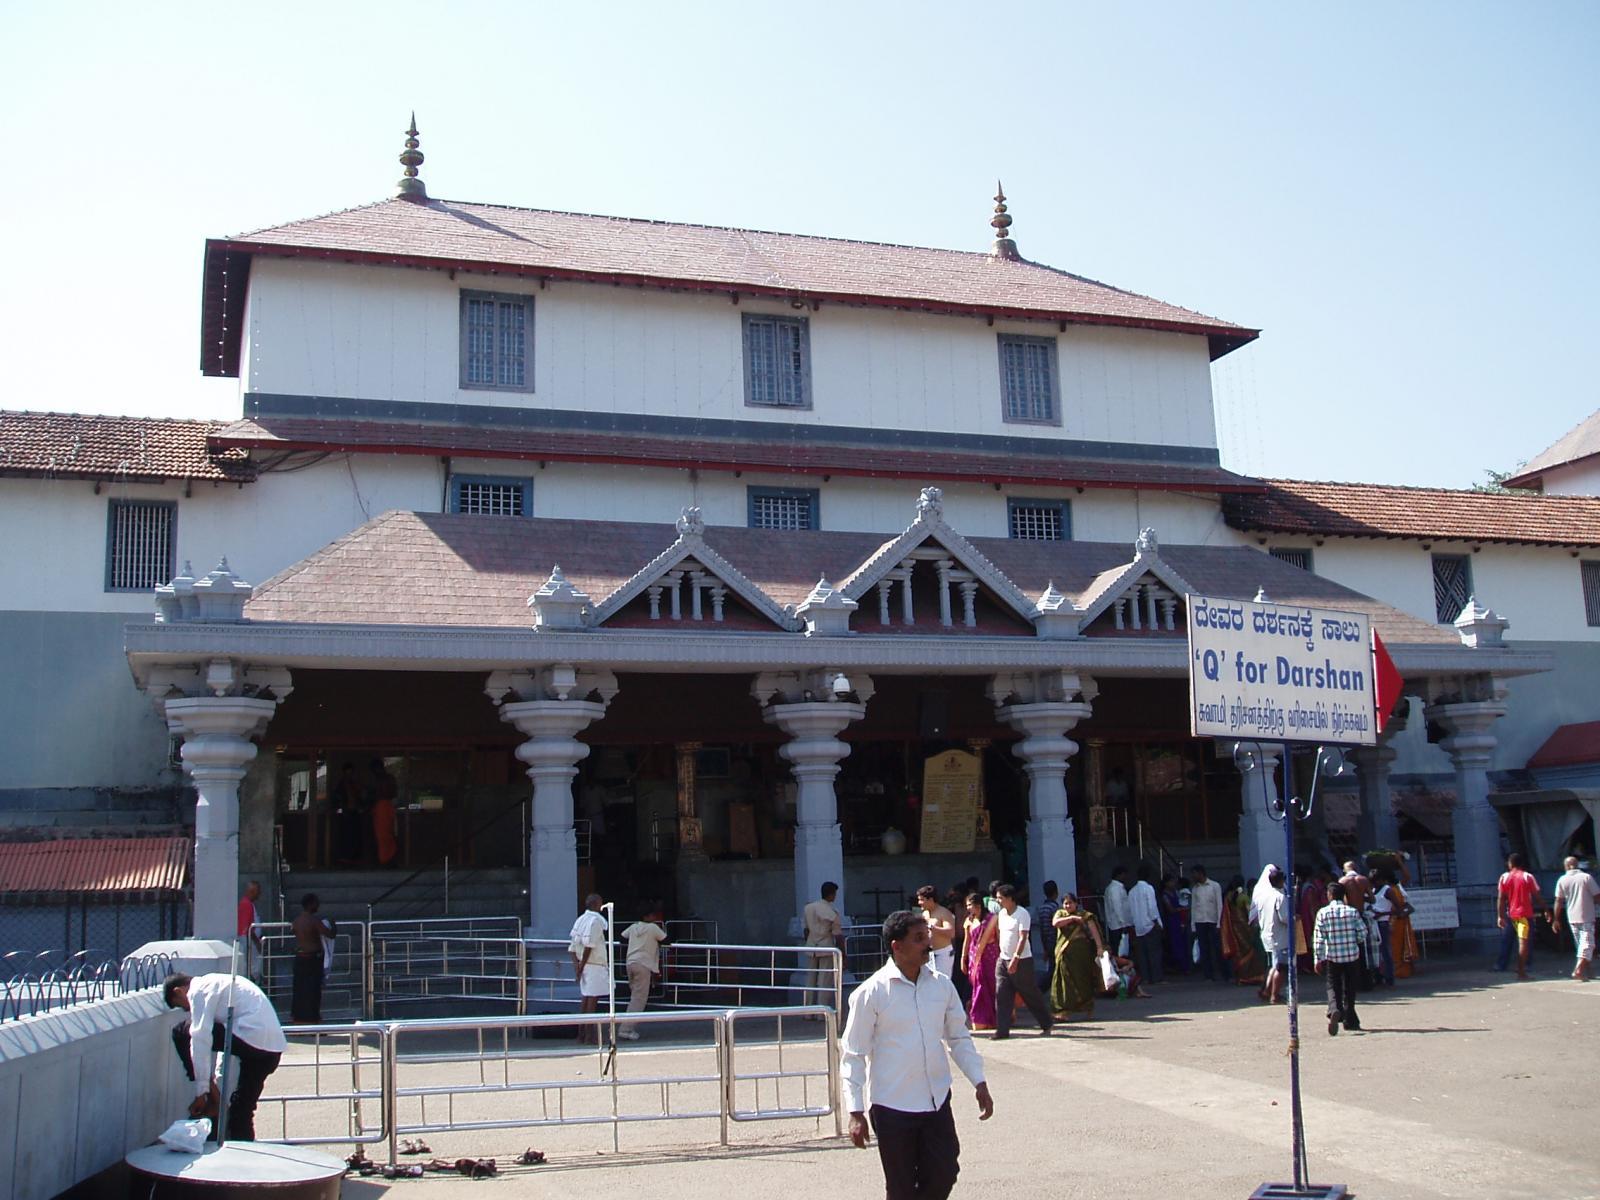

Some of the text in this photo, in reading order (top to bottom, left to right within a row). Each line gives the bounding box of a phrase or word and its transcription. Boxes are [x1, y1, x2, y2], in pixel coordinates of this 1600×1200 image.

[1195, 599, 1360, 652] ದೇವರ ದರ್ಶನಕ್ಕೆ ಸಾಲು
[1235, 651, 1268, 684] for
[1276, 655, 1364, 691] Darshan
[1199, 695, 1226, 726] சுவாமி
[1288, 700, 1328, 733] வரிசையில்
